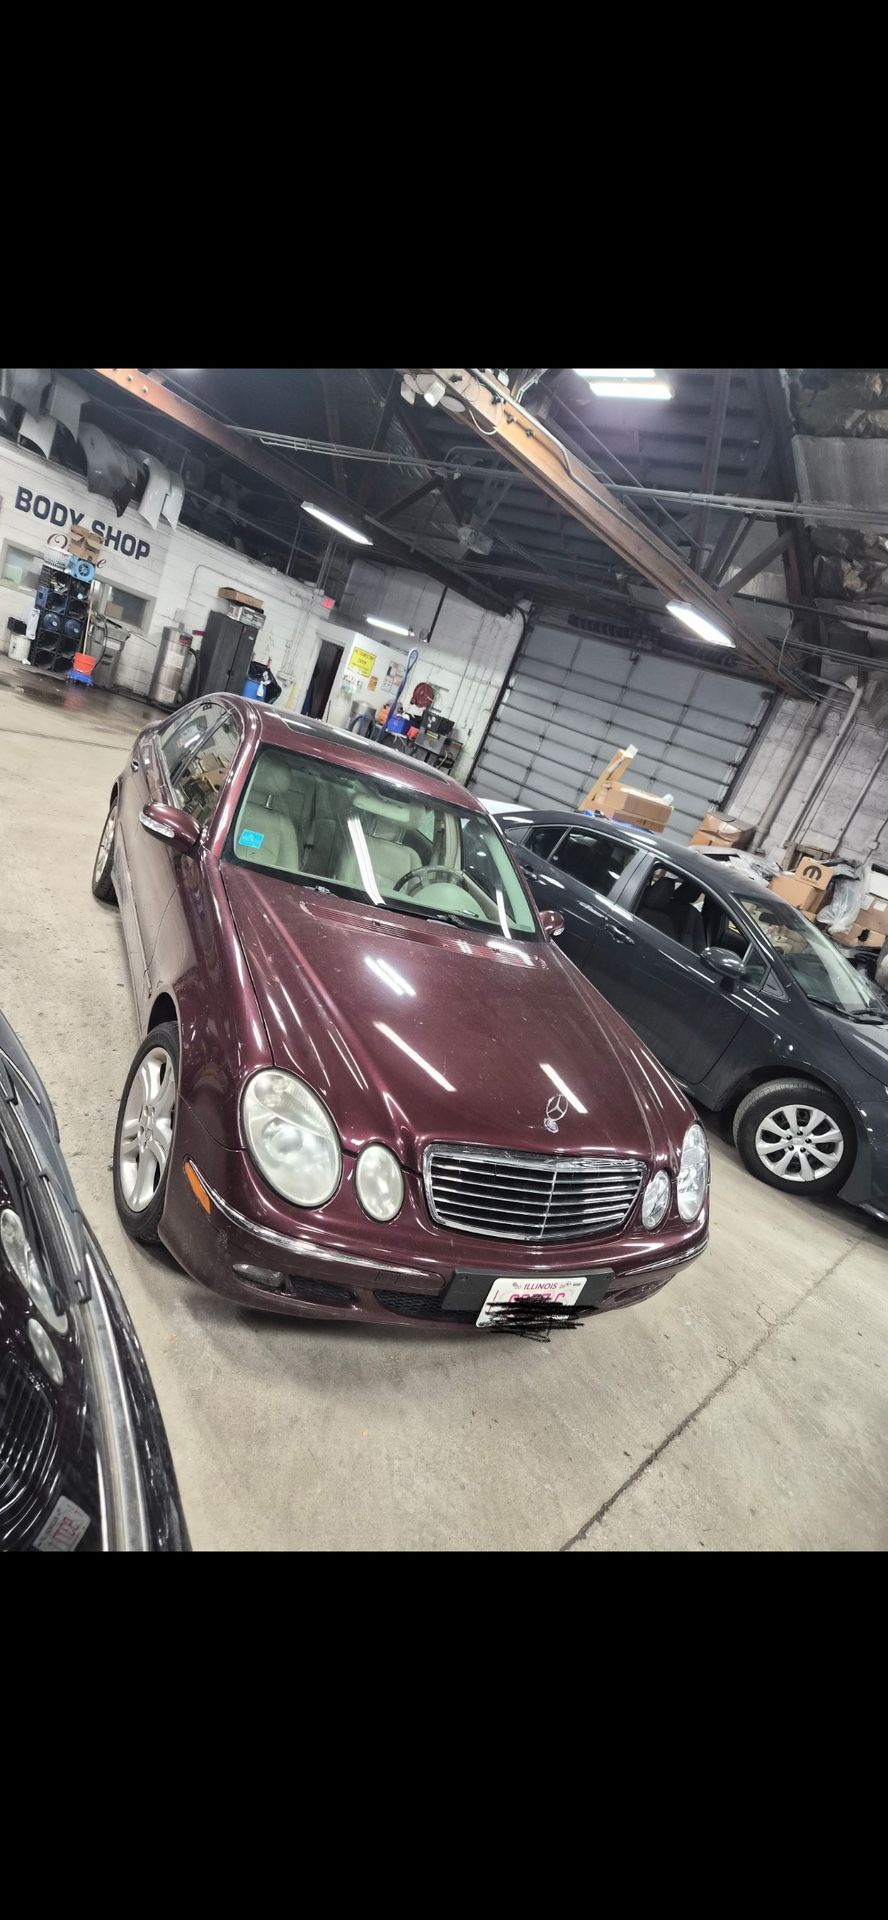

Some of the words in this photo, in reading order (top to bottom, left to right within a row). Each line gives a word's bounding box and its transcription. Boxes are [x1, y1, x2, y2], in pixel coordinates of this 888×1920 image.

[14, 486, 85, 527] BODY
[92, 520, 150, 560] SHOP
[523, 1282, 558, 1290] ILLINOIS
